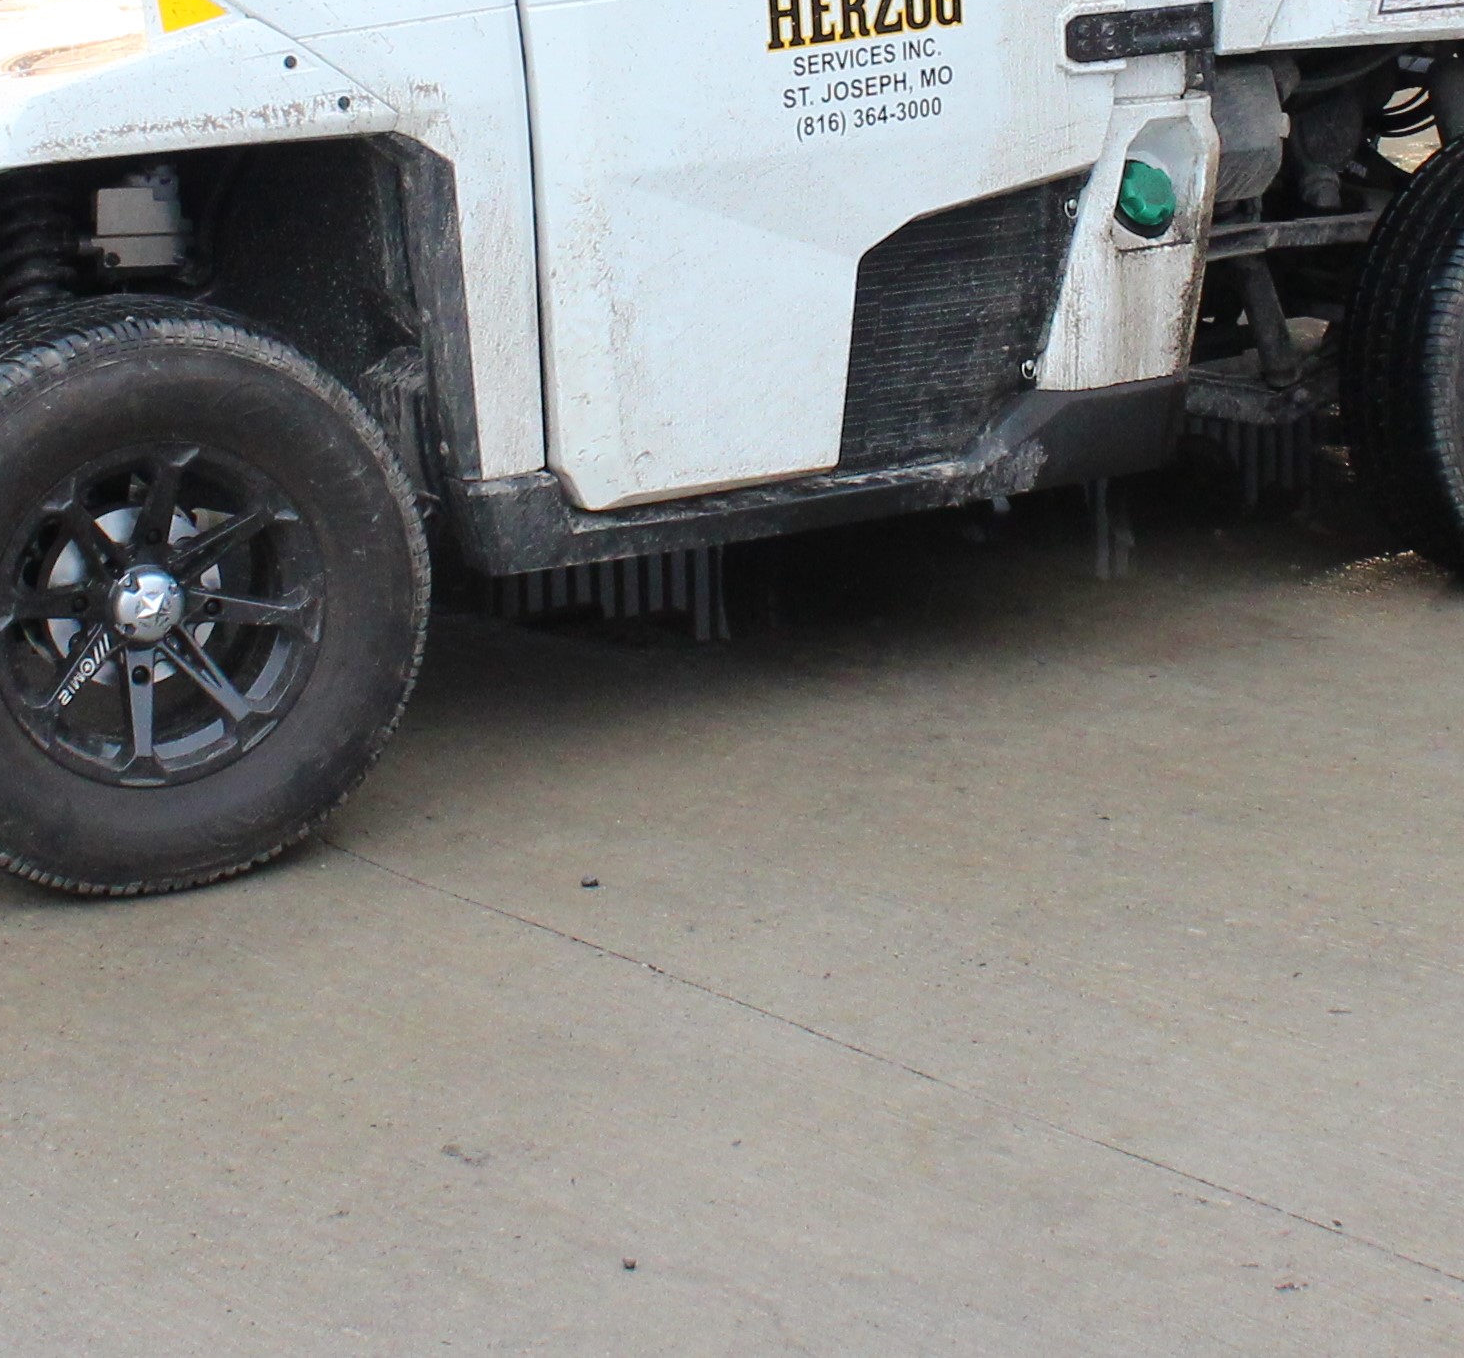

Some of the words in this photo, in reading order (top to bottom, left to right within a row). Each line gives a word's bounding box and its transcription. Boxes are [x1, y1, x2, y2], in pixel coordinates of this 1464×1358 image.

[792, 43, 896, 76] SERVICES
[902, 37, 942, 62] INC.
[783, 85, 815, 109] ST.
[821, 71, 913, 104] JOSEPH,
[920, 65, 954, 89] MO
[796, 111, 847, 143] (816)
[853, 96, 943, 129] 364-3000
